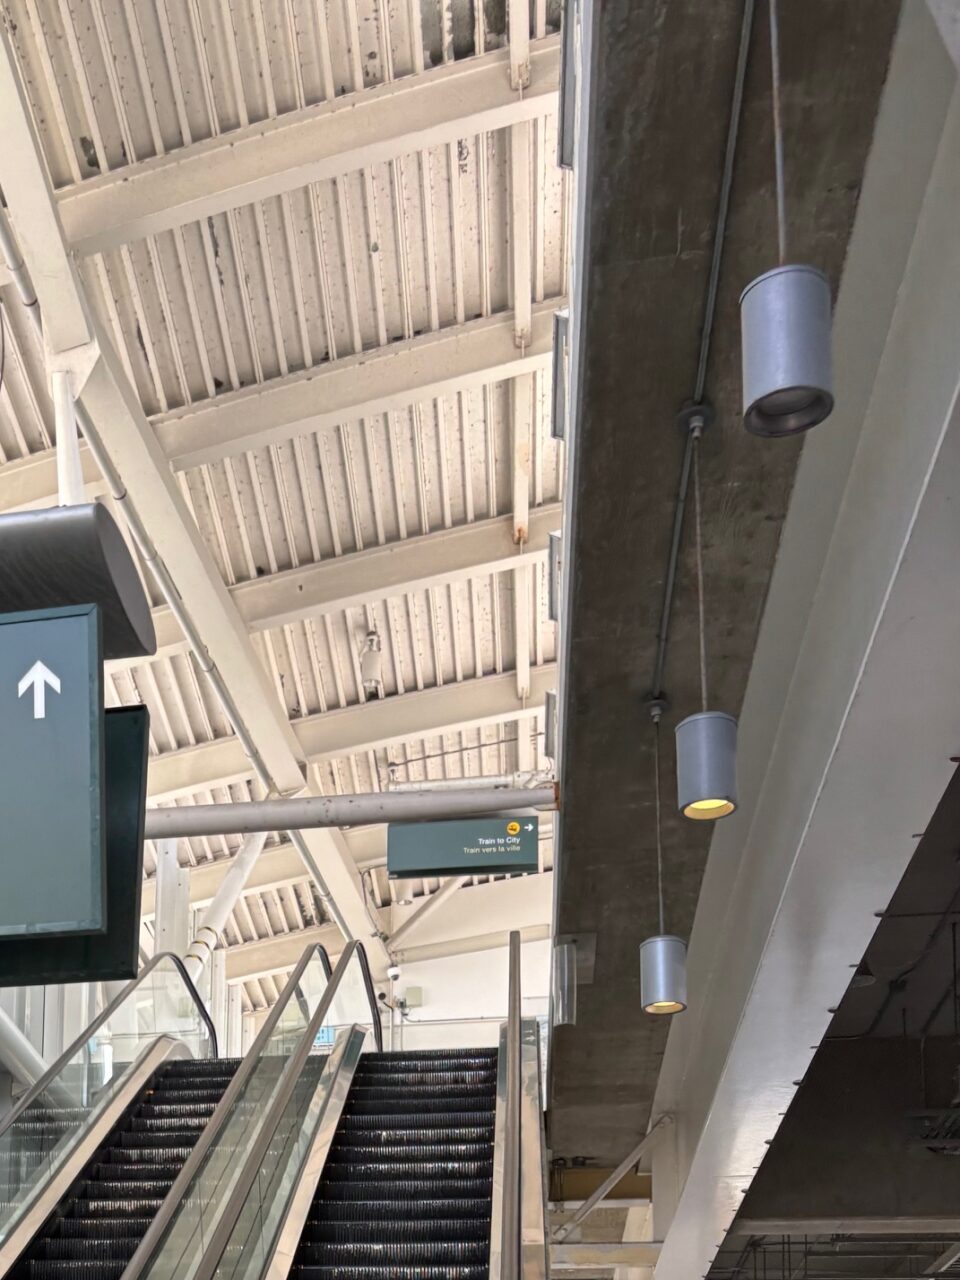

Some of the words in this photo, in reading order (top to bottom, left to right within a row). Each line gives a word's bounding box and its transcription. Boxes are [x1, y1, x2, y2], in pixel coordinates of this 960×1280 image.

[478, 838, 496, 846] Train
[506, 836, 521, 845] City
[463, 846, 481, 854] Train
